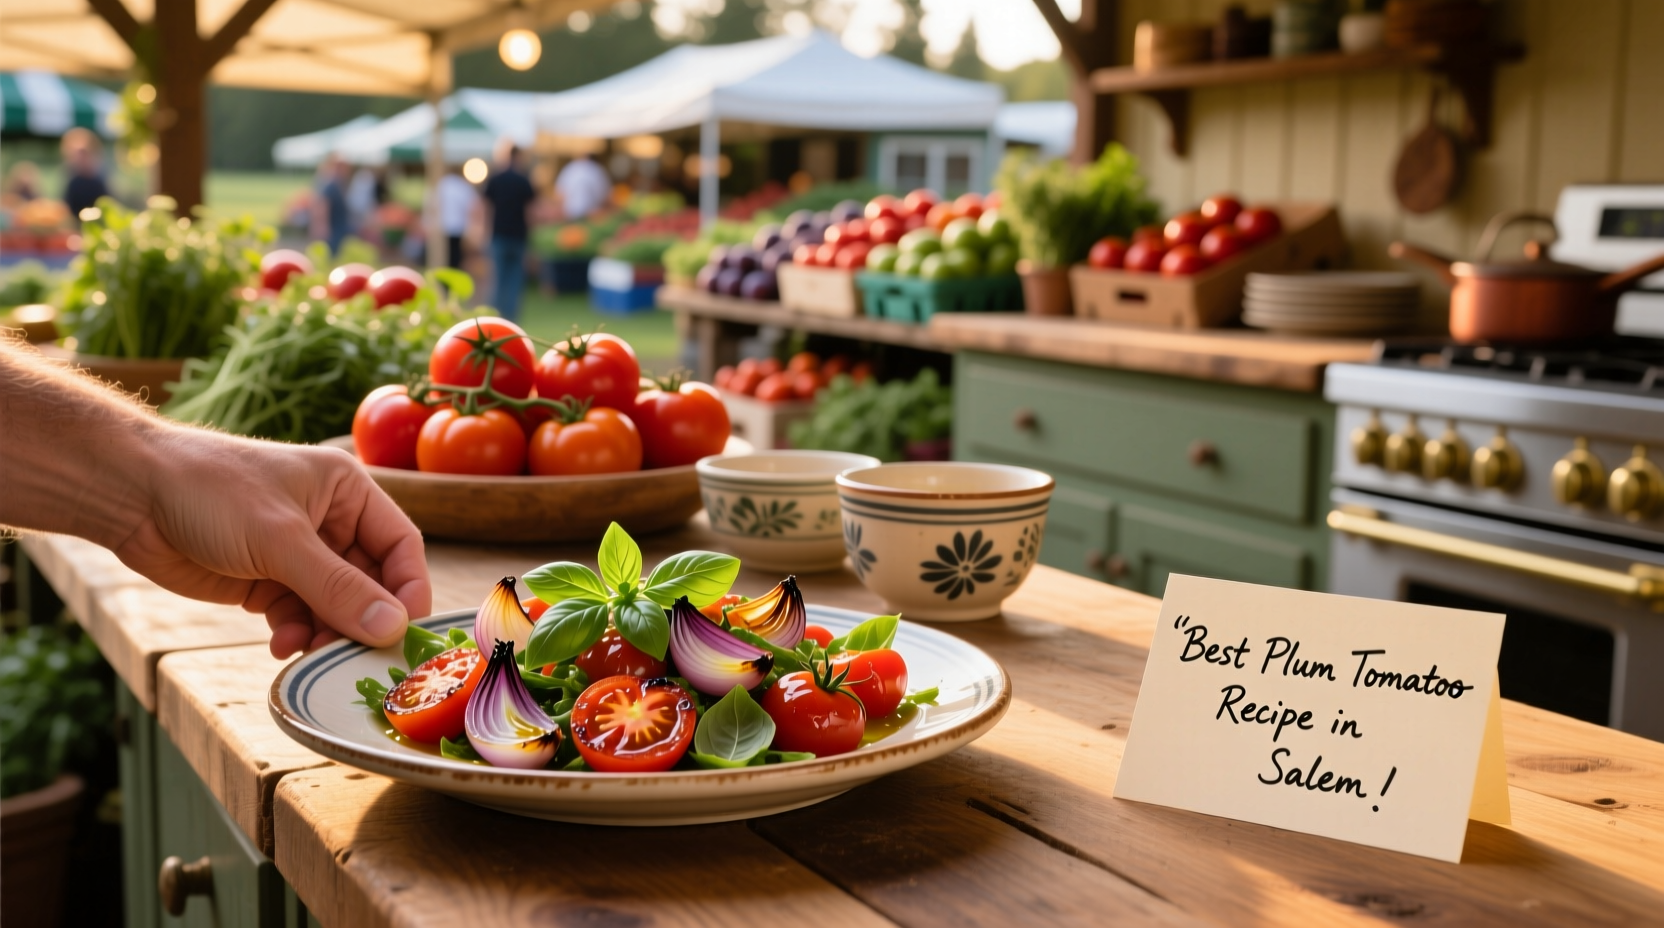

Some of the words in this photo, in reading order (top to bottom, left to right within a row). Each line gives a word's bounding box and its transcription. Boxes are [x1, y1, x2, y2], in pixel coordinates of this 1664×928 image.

[1260, 636, 1336, 682] Plum
[1215, 684, 1314, 743] Recipe
[1330, 709, 1363, 739] in
